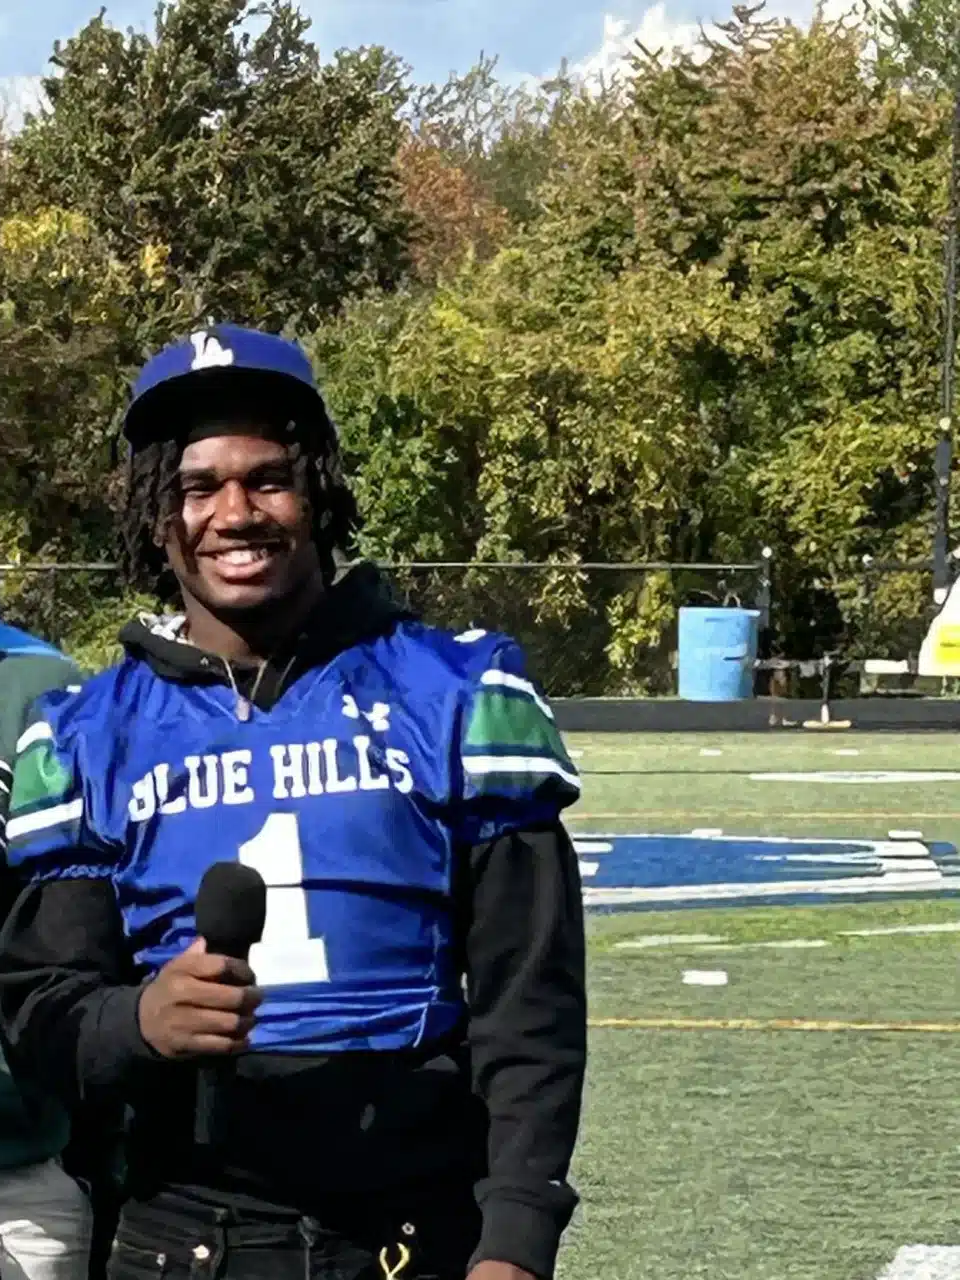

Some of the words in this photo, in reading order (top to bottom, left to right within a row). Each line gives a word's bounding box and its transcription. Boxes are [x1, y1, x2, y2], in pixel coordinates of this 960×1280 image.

[128, 750, 254, 822] BLUE
[270, 735, 413, 799] HILLS
[238, 812, 331, 986] 1
